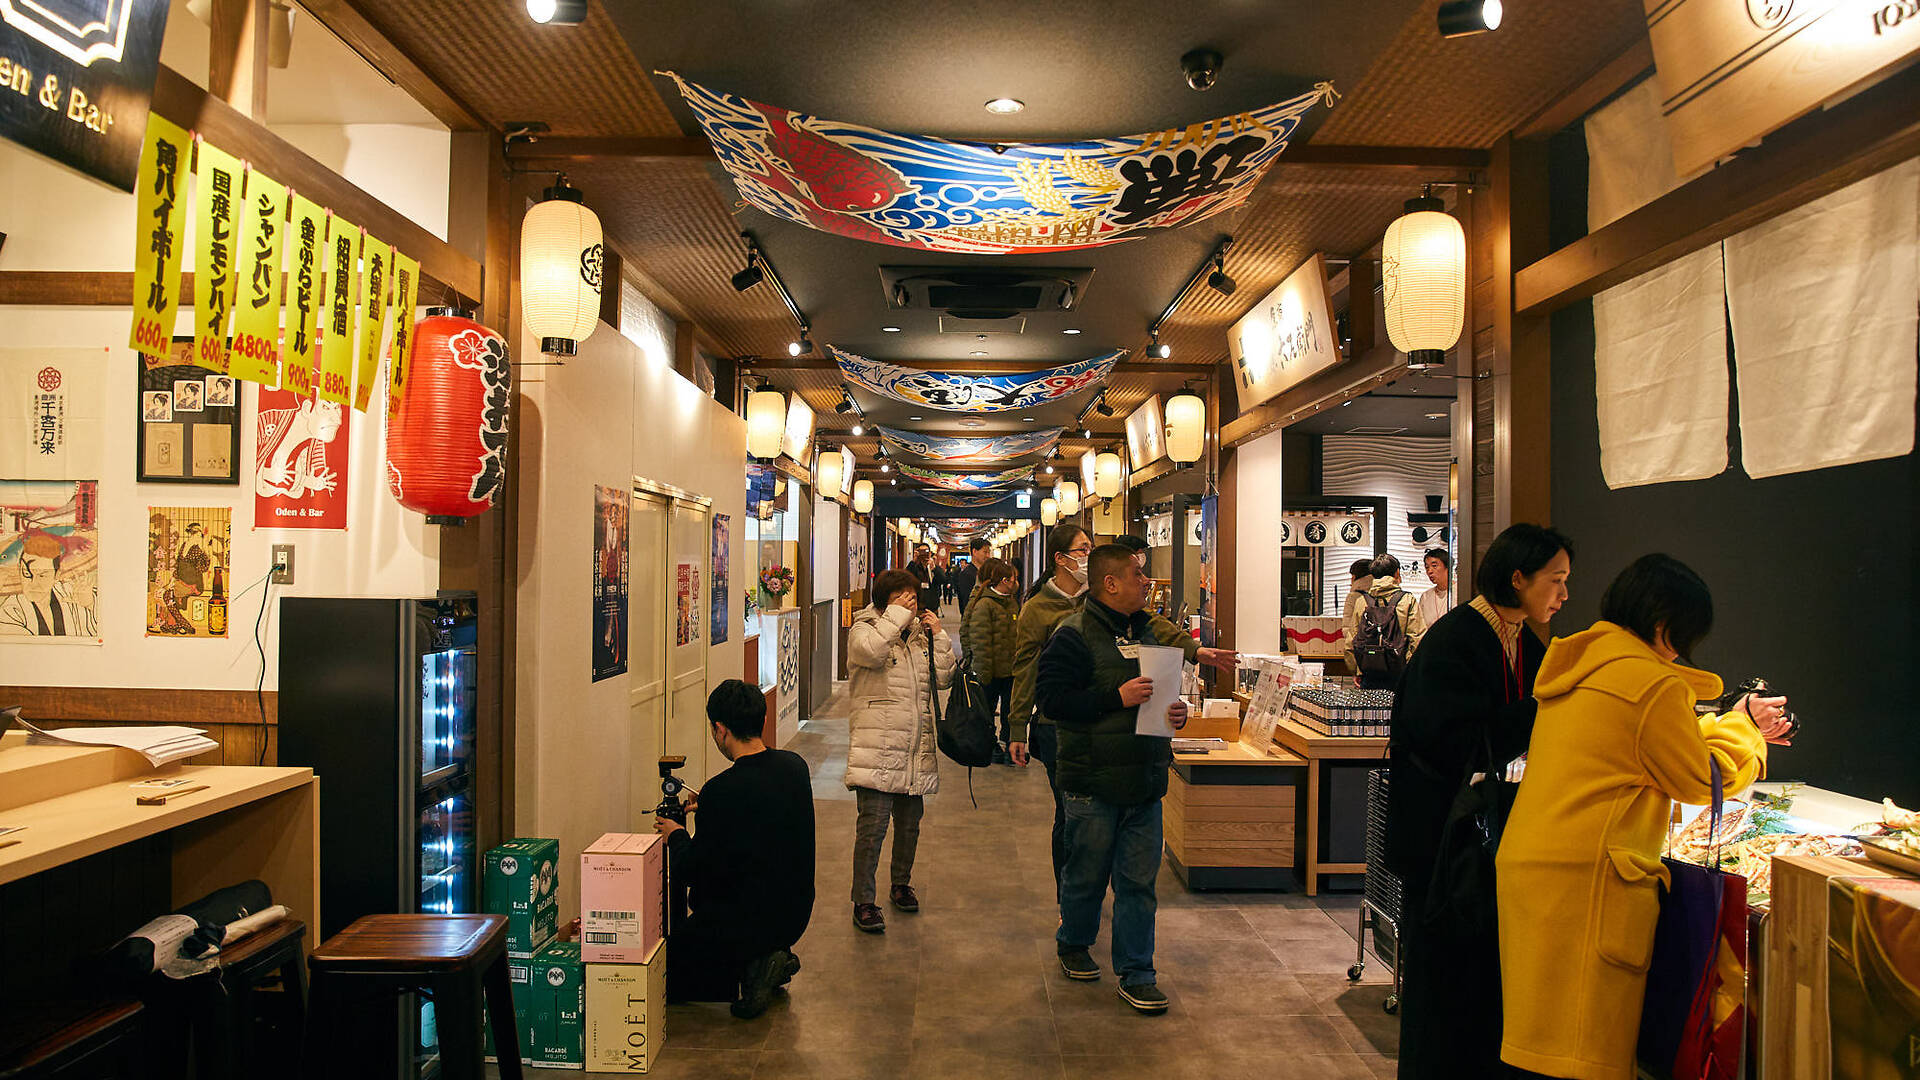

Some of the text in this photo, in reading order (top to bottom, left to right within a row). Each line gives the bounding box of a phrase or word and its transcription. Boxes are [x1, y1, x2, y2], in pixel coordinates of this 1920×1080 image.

[39, 74, 61, 111] &
[67, 87, 113, 135] Bar
[147, 137, 178, 314] 角ハイボール
[208, 167, 231, 336] 国産レモンハイ
[252, 193, 275, 309] シャンパン
[136, 317, 168, 354] 660円
[40, 401, 57, 455] 千客万来
[275, 507, 325, 517] Oden & Bar
[624, 993, 646, 1071] MOËT
